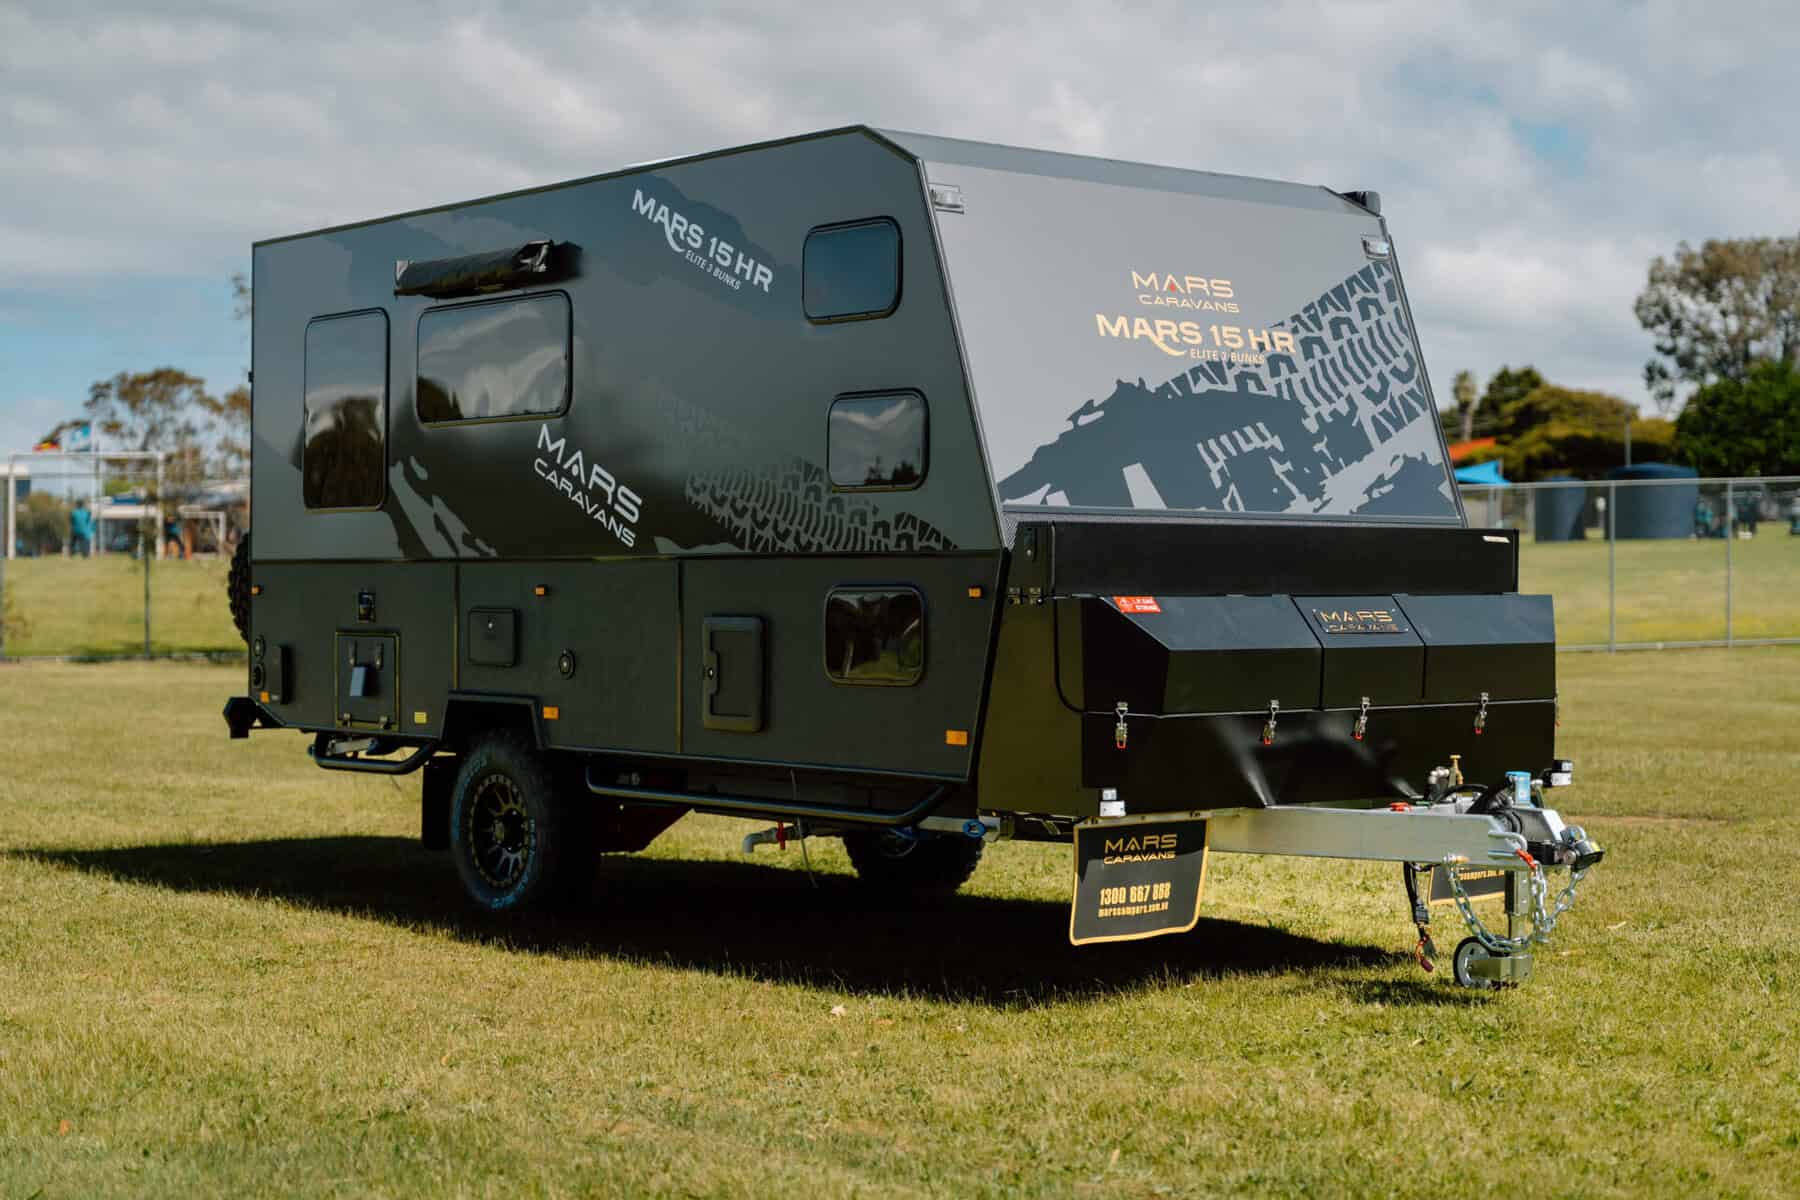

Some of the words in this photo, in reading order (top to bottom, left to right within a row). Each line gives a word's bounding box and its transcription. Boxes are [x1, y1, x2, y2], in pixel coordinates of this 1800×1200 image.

[632, 189, 704, 252] MARS
[708, 236, 734, 266] 15
[735, 251, 773, 293] HR
[685, 249, 707, 271] ELITE
[713, 269, 742, 290] BUNKS
[1131, 271, 1234, 299] MARS
[1138, 294, 1240, 314] CARAVANS
[1096, 313, 1202, 357] MARS
[1209, 324, 1244, 350] 15
[1248, 328, 1297, 353] HR
[1190, 347, 1219, 361] ELITE
[1230, 351, 1266, 365] BUNKS
[537, 423, 643, 524] MARS
[534, 457, 636, 548] CARAVANS
[1103, 850, 1176, 865] CARAVANS
[1104, 833, 1177, 854] MARS
[1100, 887, 1127, 906] 1300
